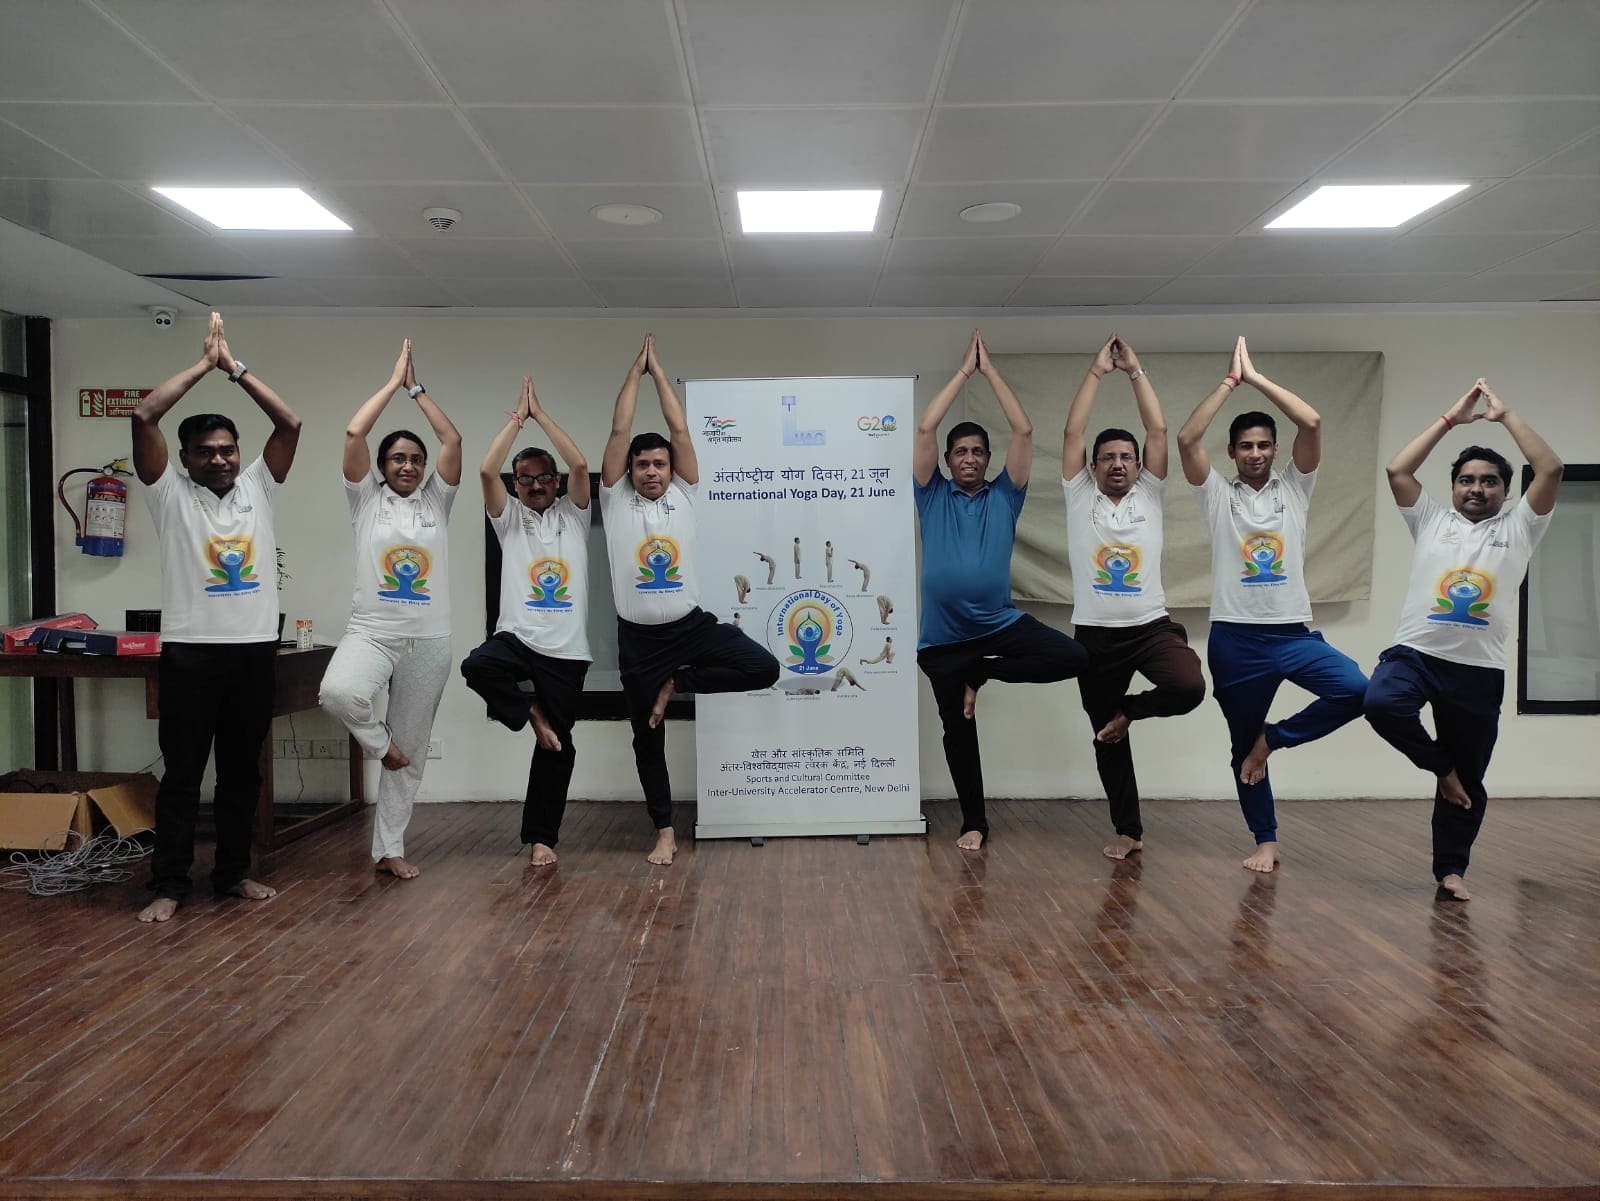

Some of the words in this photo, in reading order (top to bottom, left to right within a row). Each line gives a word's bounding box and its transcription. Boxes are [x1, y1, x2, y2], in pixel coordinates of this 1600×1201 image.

[124, 390, 140, 398] FIRE
[106, 398, 143, 406] EXTINGUI
[857, 415, 897, 432] G20
[781, 466, 805, 481] योग
[811, 466, 847, 482] दिवस,
[851, 468, 866, 480] 21
[868, 467, 891, 484] जून
[708, 487, 787, 501] International
[790, 488, 818, 501] Yoga
[821, 487, 847, 500] Day,
[850, 487, 865, 498] 21
[868, 487, 896, 498] June
[813, 591, 831, 604] Day
[830, 601, 841, 612] of
[776, 591, 813, 637] International
[835, 612, 844, 636] Yoga
[751, 748, 768, 758] खेल
[771, 748, 787, 758] और
[791, 747, 833, 760] सांस्कृतिक
[837, 746, 865, 757] समिति
[854, 757, 867, 769] नई
[870, 757, 897, 768] दिल्ली
[746, 775, 773, 784] Sports
[774, 774, 790, 782] and
[791, 773, 823, 782] Cultural
[825, 772, 871, 781] Committee
[707, 786, 776, 797] Inter-University
[778, 785, 828, 795] Accelerator
[830, 785, 862, 795] Centre,
[864, 784, 885, 793] New
[887, 783, 910, 793] Delhi
